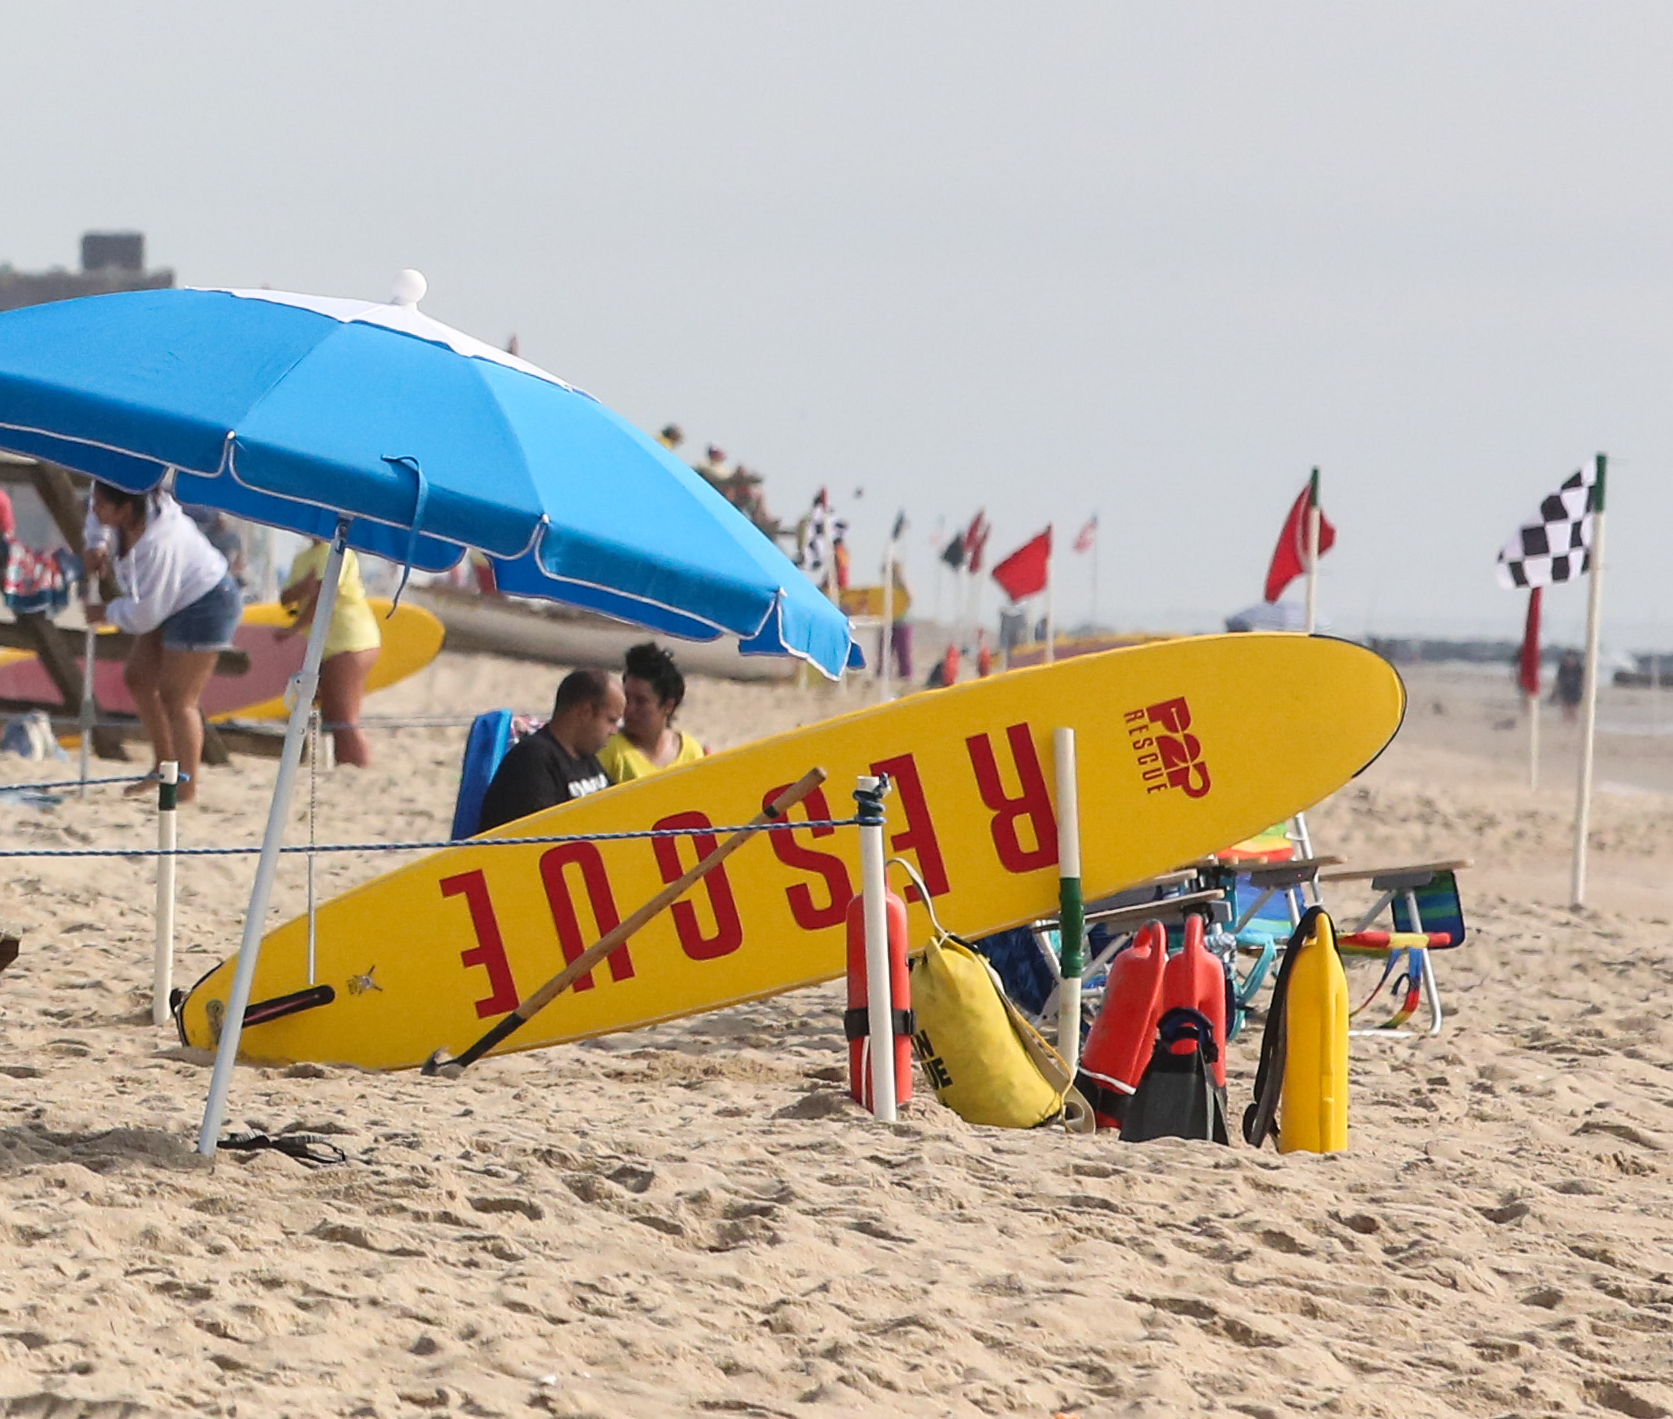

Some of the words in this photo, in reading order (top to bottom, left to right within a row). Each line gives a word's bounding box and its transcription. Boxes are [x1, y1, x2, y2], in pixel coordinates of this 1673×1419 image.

[1124, 708, 1168, 795] RESCUE
[1146, 696, 1212, 799] P2P
[439, 721, 1060, 1020] RESCUE
